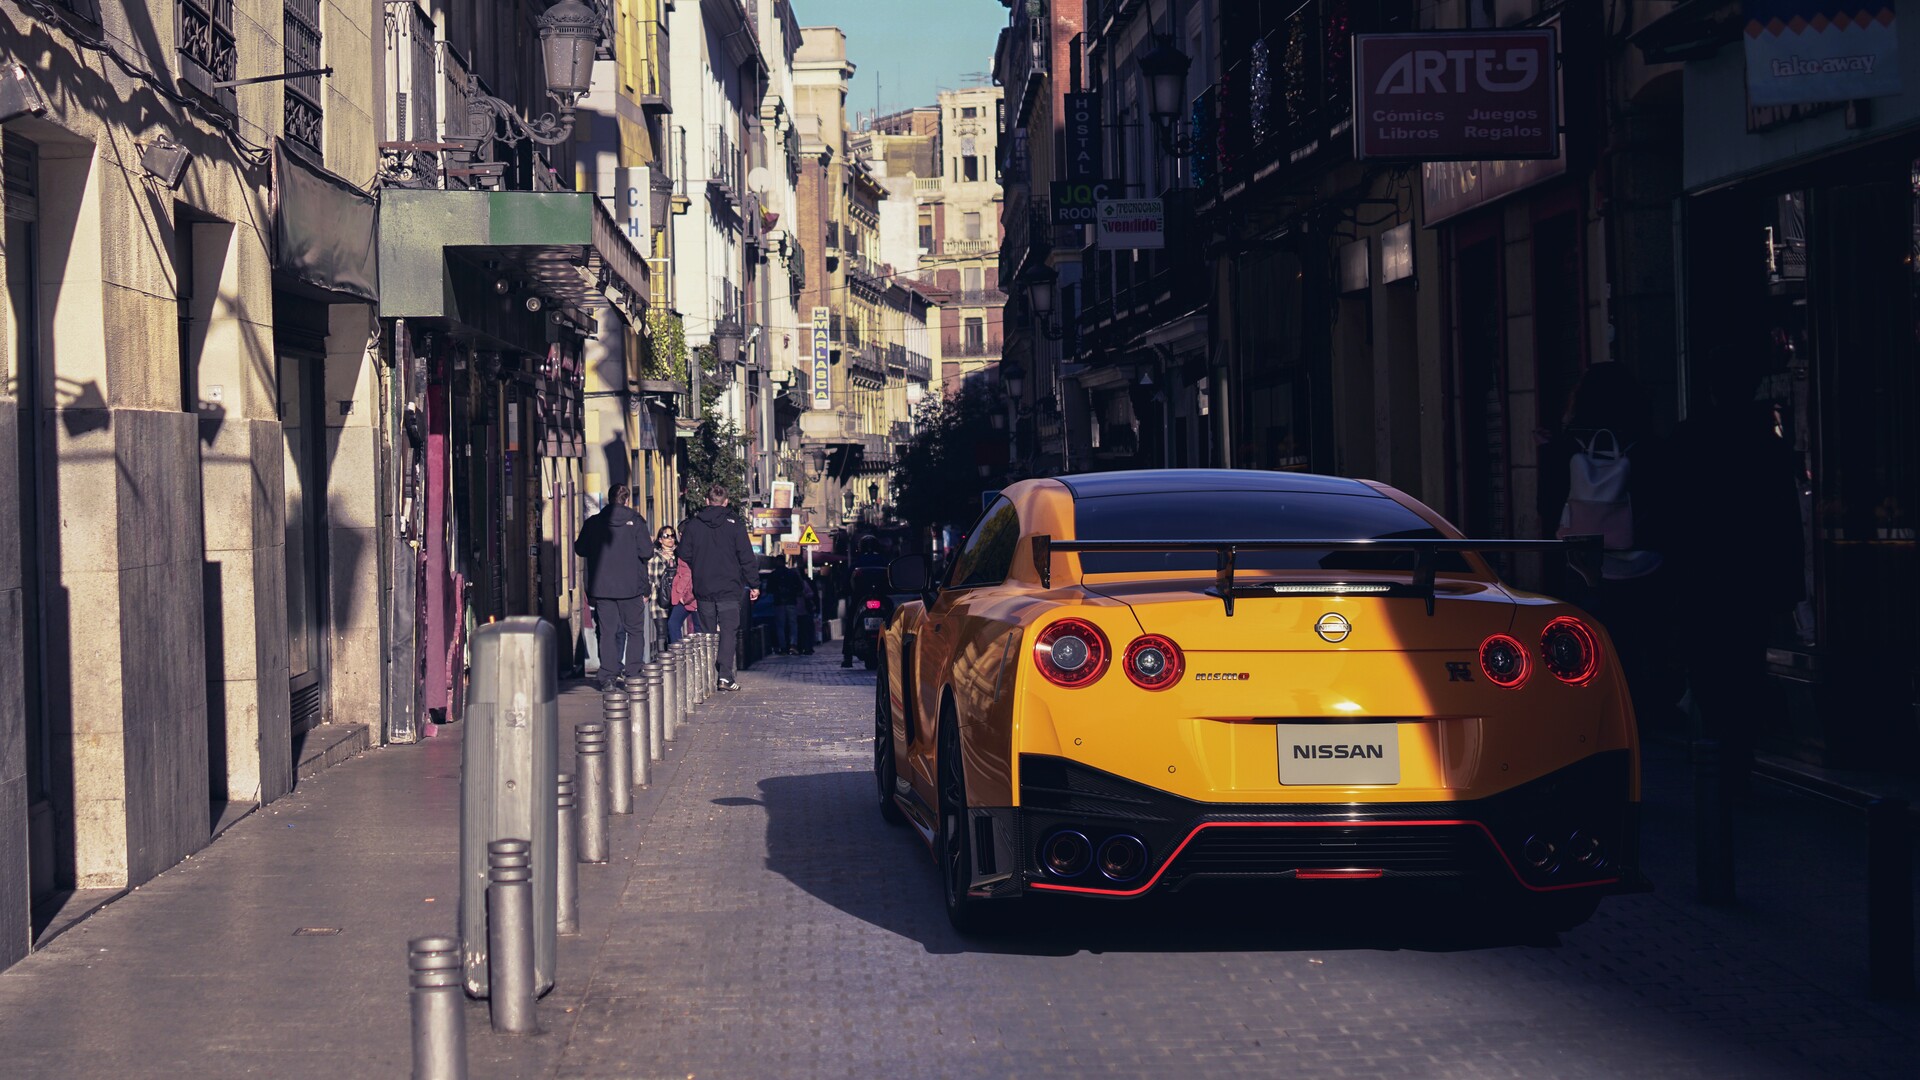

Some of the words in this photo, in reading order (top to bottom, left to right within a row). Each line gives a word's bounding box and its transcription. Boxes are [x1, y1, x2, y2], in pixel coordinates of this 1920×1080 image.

[1372, 109, 1445, 122] Cómics
[1467, 108, 1538, 123] Juegos
[1075, 98, 1091, 175] HOSTAL
[1378, 127, 1440, 139] Libros
[1464, 125, 1543, 140] Regalos
[1117, 202, 1161, 214] TECNOCASA
[1108, 218, 1157, 232] vendido
[814, 320, 828, 399] MARLASCA
[1293, 744, 1383, 759] NISSAN
